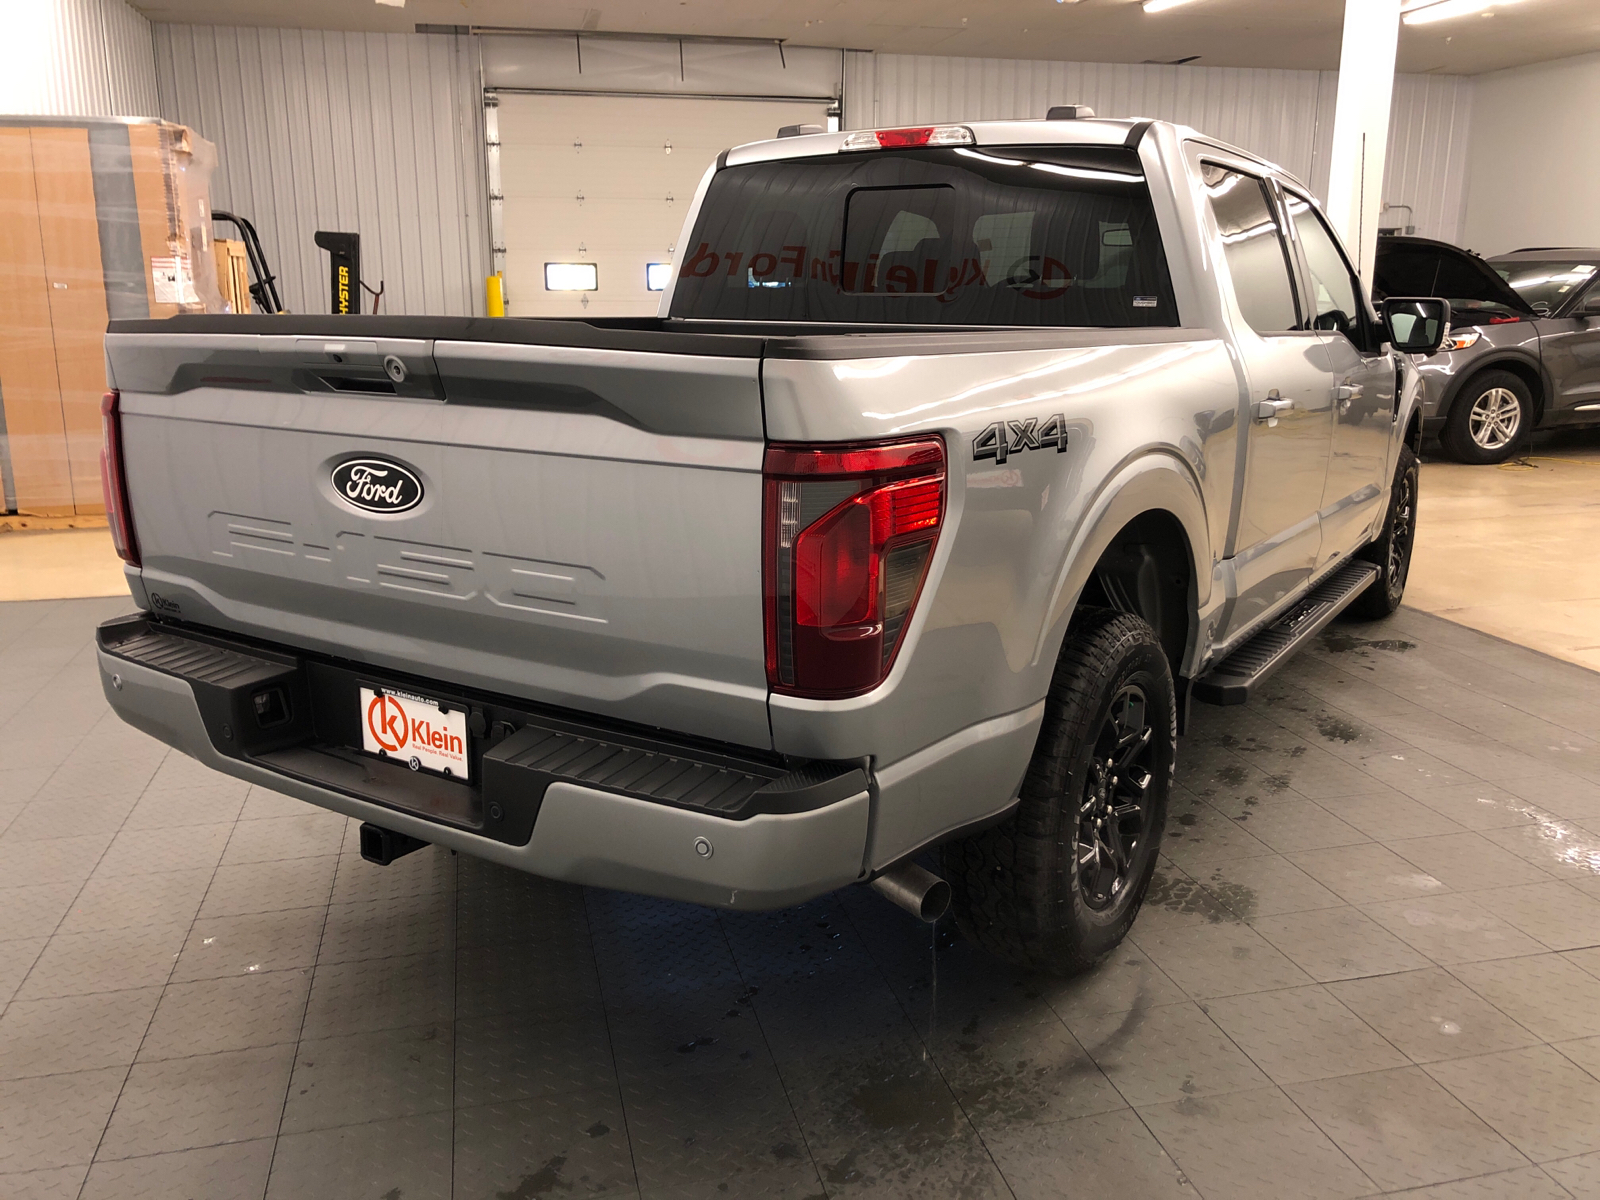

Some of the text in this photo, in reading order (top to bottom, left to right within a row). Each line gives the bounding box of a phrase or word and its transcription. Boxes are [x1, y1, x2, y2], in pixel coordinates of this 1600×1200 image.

[346, 465, 403, 504] Ford
[381, 687, 439, 706] www.kleinauto.com
[411, 718, 463, 754] Klein
